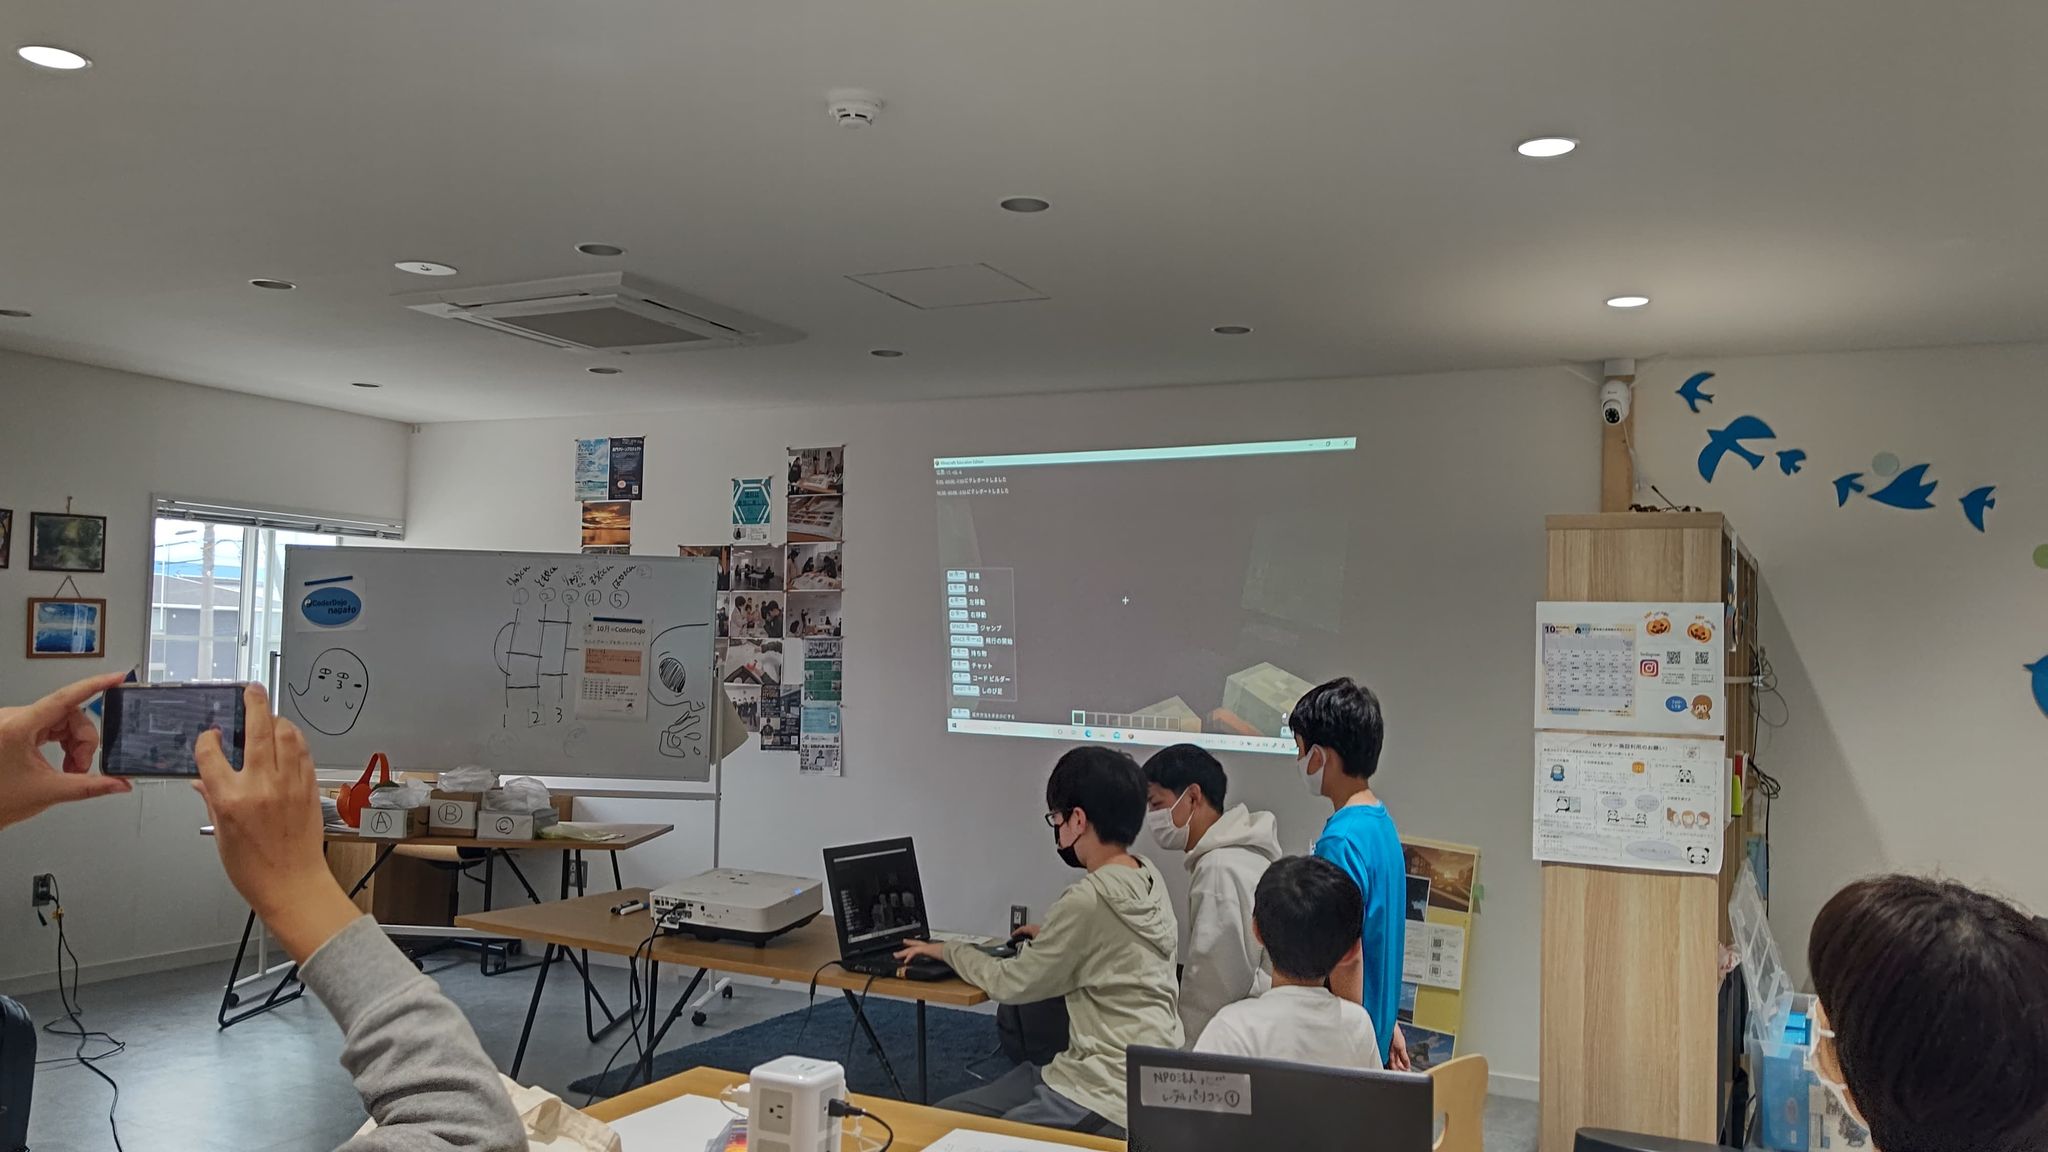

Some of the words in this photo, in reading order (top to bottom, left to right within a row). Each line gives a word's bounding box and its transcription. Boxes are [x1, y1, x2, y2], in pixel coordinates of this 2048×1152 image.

[313, 599, 347, 607] CoderDojo
[328, 606, 356, 614] nagato
[532, 711, 540, 724] 2
[555, 706, 563, 723] 3
